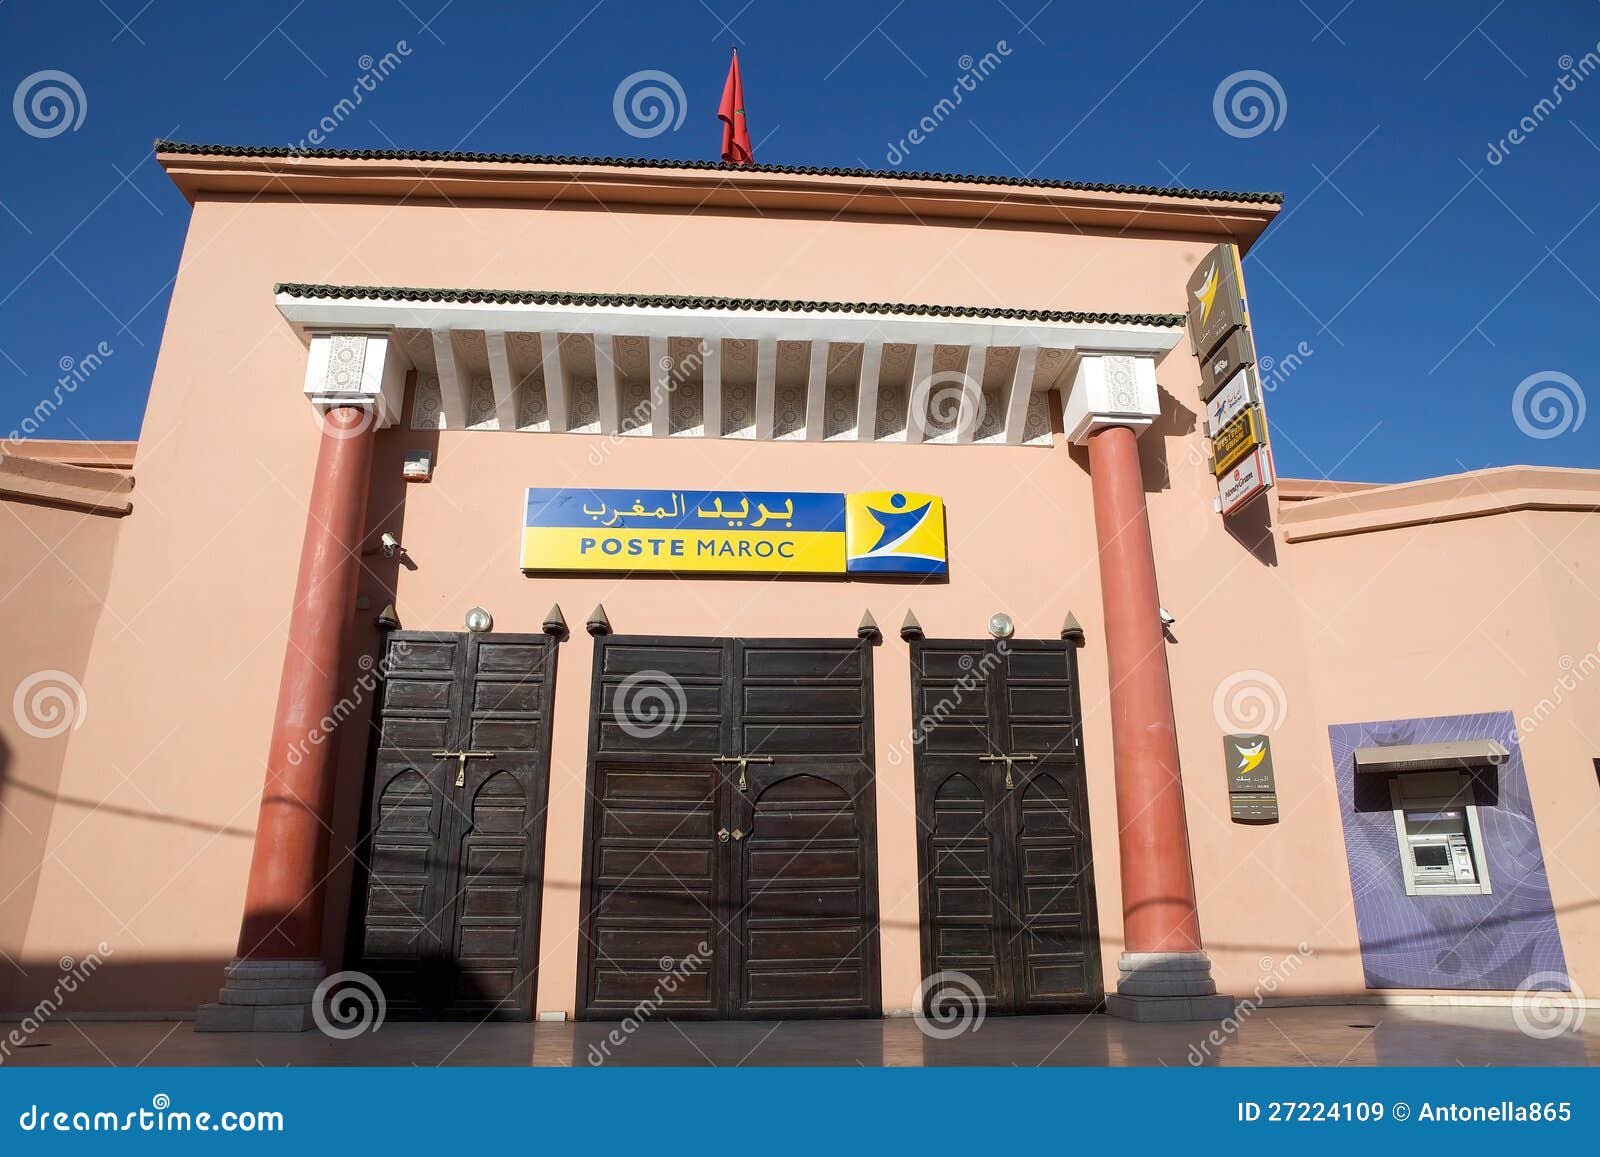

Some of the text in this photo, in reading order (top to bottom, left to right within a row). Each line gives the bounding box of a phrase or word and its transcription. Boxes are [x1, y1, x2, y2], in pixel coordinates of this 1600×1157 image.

[582, 492, 793, 528] بريد المغرب
[580, 537, 795, 559] POSTE MAROC
